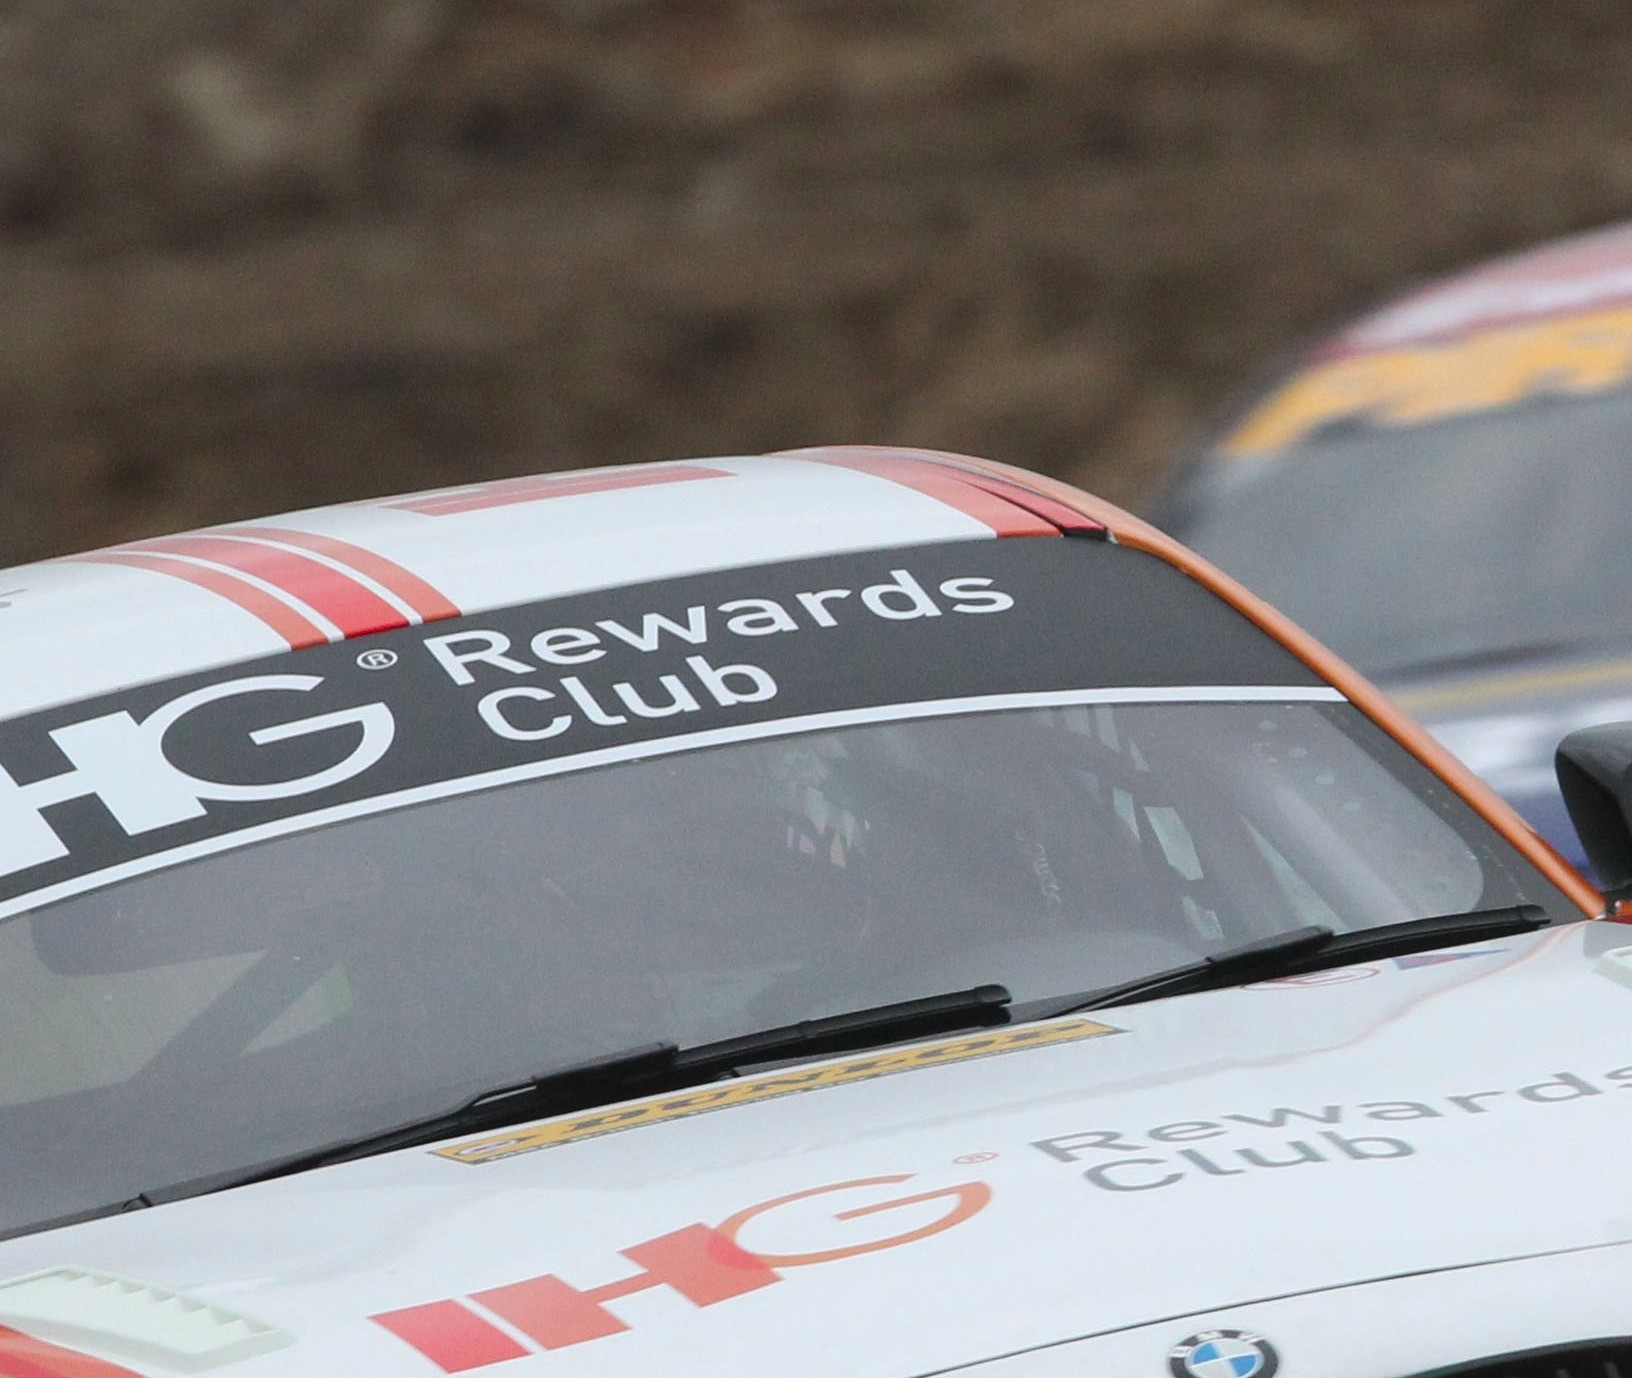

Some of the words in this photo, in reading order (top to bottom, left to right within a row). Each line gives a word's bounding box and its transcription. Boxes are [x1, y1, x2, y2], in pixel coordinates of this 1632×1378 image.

[423, 569, 1015, 686] Rewards
[477, 655, 778, 741] Club
[558, 1019, 1088, 1136] DUNLOP
[1083, 1131, 1416, 1192] Club
